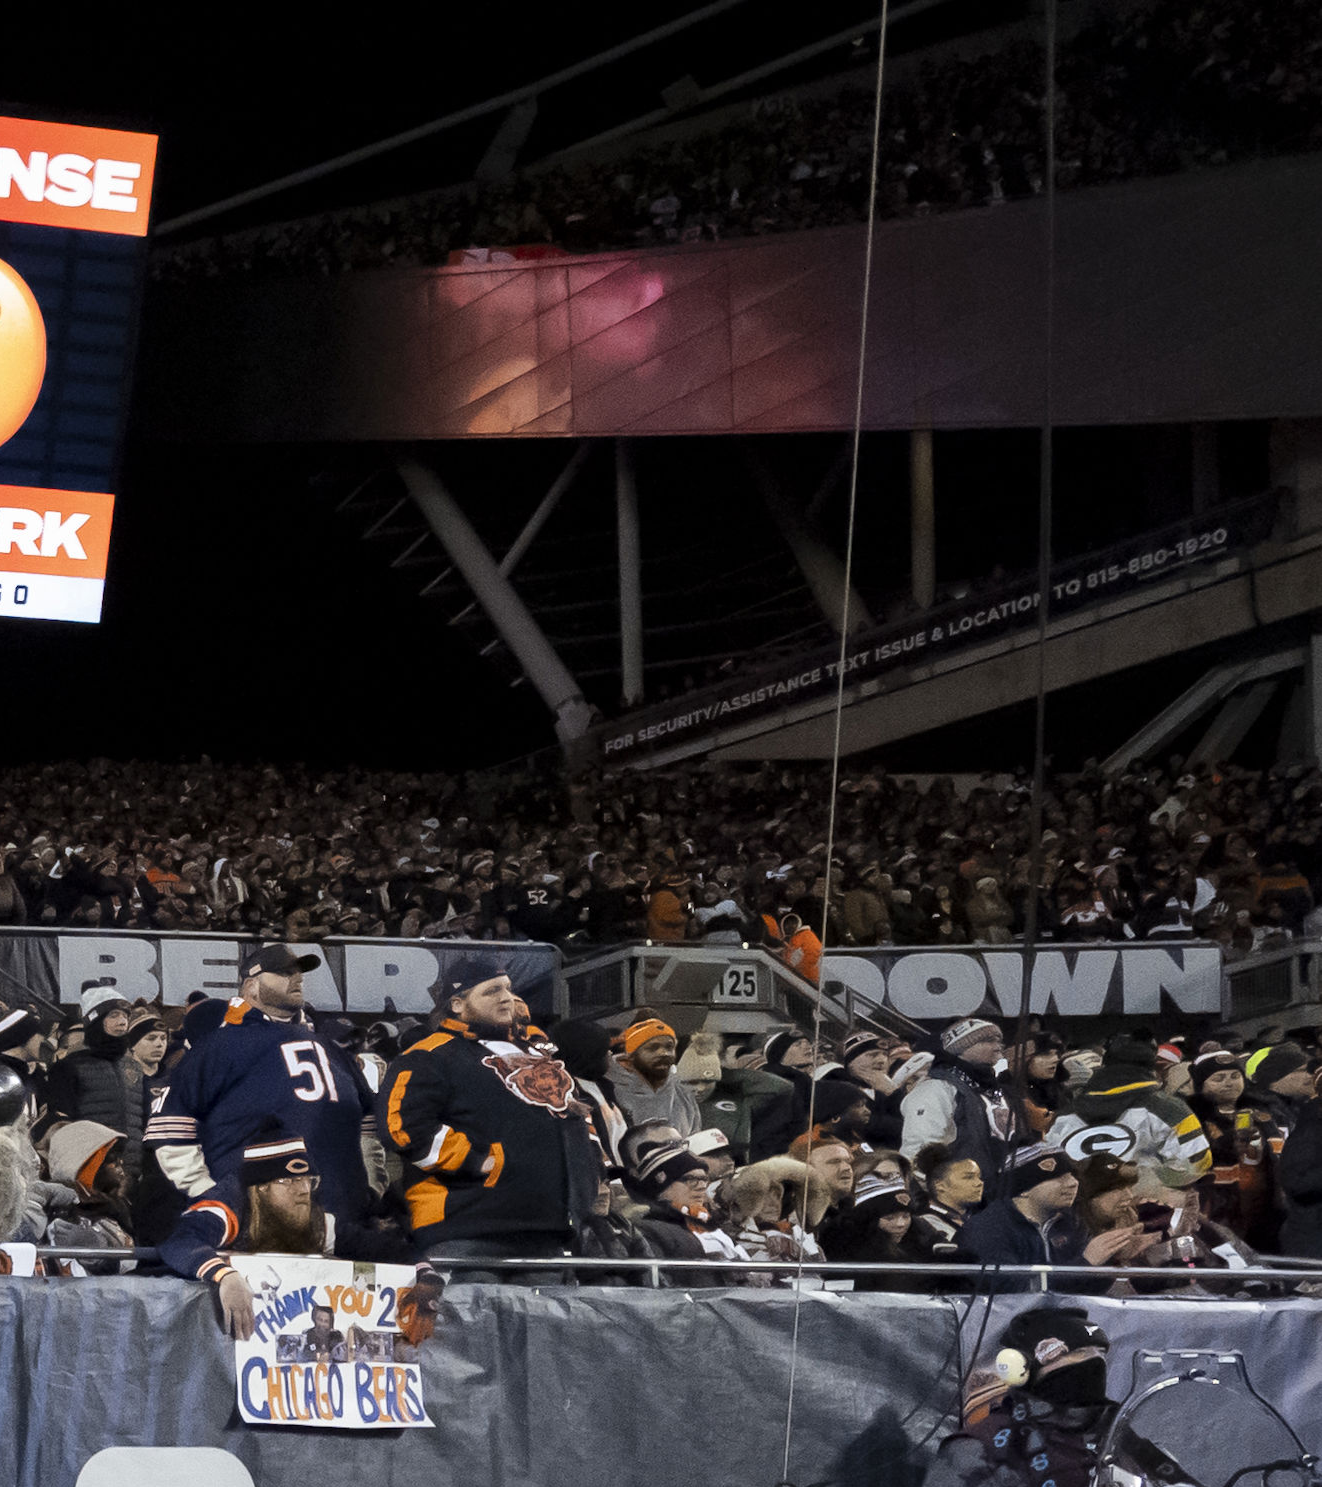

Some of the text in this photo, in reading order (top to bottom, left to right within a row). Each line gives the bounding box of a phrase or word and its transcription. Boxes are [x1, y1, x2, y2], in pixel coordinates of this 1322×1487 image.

[603, 733, 635, 755] FOR
[637, 667, 822, 744] SECURITY/ASSISTANCE
[824, 651, 871, 681] TEXT
[874, 631, 928, 663] ISSUE
[931, 626, 944, 643] &
[1054, 577, 1081, 601] TO
[1086, 526, 1229, 590] 815-880-1920
[527, 890, 548, 905] 52
[819, 949, 1222, 1016] DOWN
[281, 1038, 339, 1102] 51
[254, 1285, 318, 1344] THANK
[324, 1284, 374, 1318] YOU
[242, 1356, 426, 1424] CHICAGO BEARS
